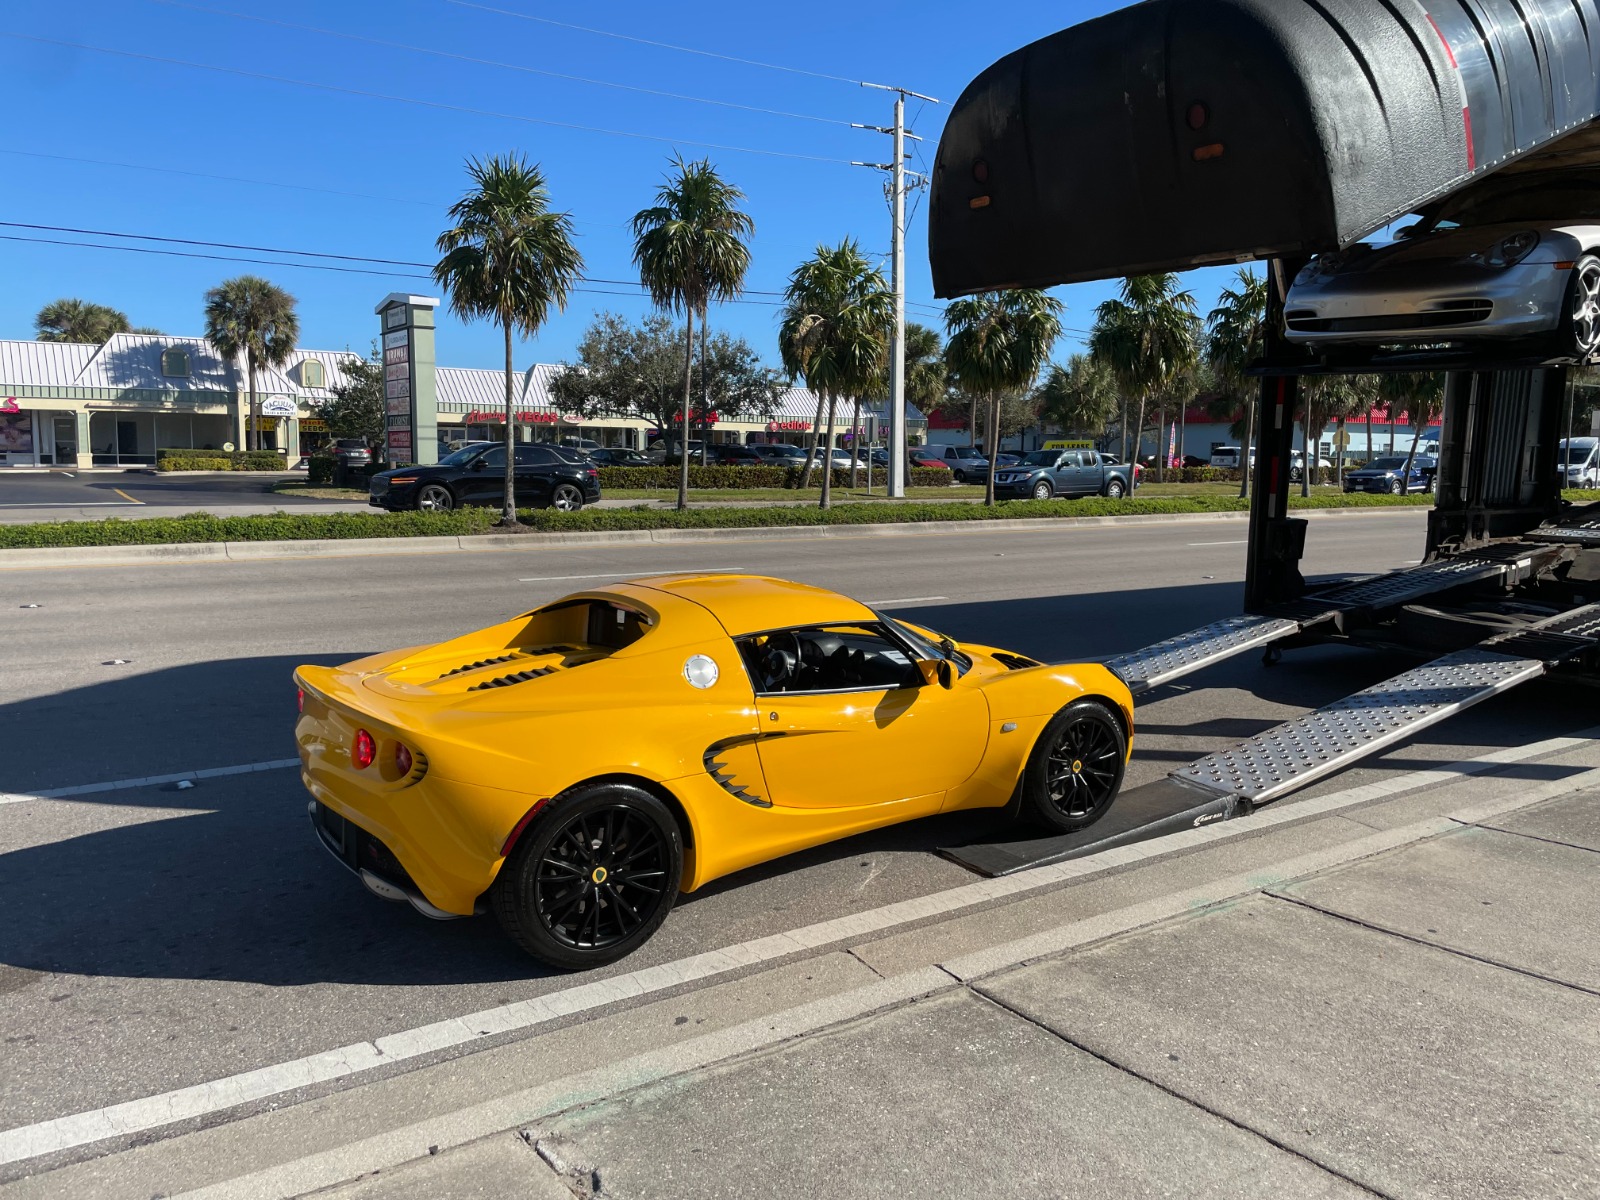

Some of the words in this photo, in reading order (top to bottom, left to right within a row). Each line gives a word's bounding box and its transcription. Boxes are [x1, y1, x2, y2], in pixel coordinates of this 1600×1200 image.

[263, 400, 294, 411] VACUUM
[515, 411, 558, 423] VEGAS
[781, 421, 812, 430] edible
